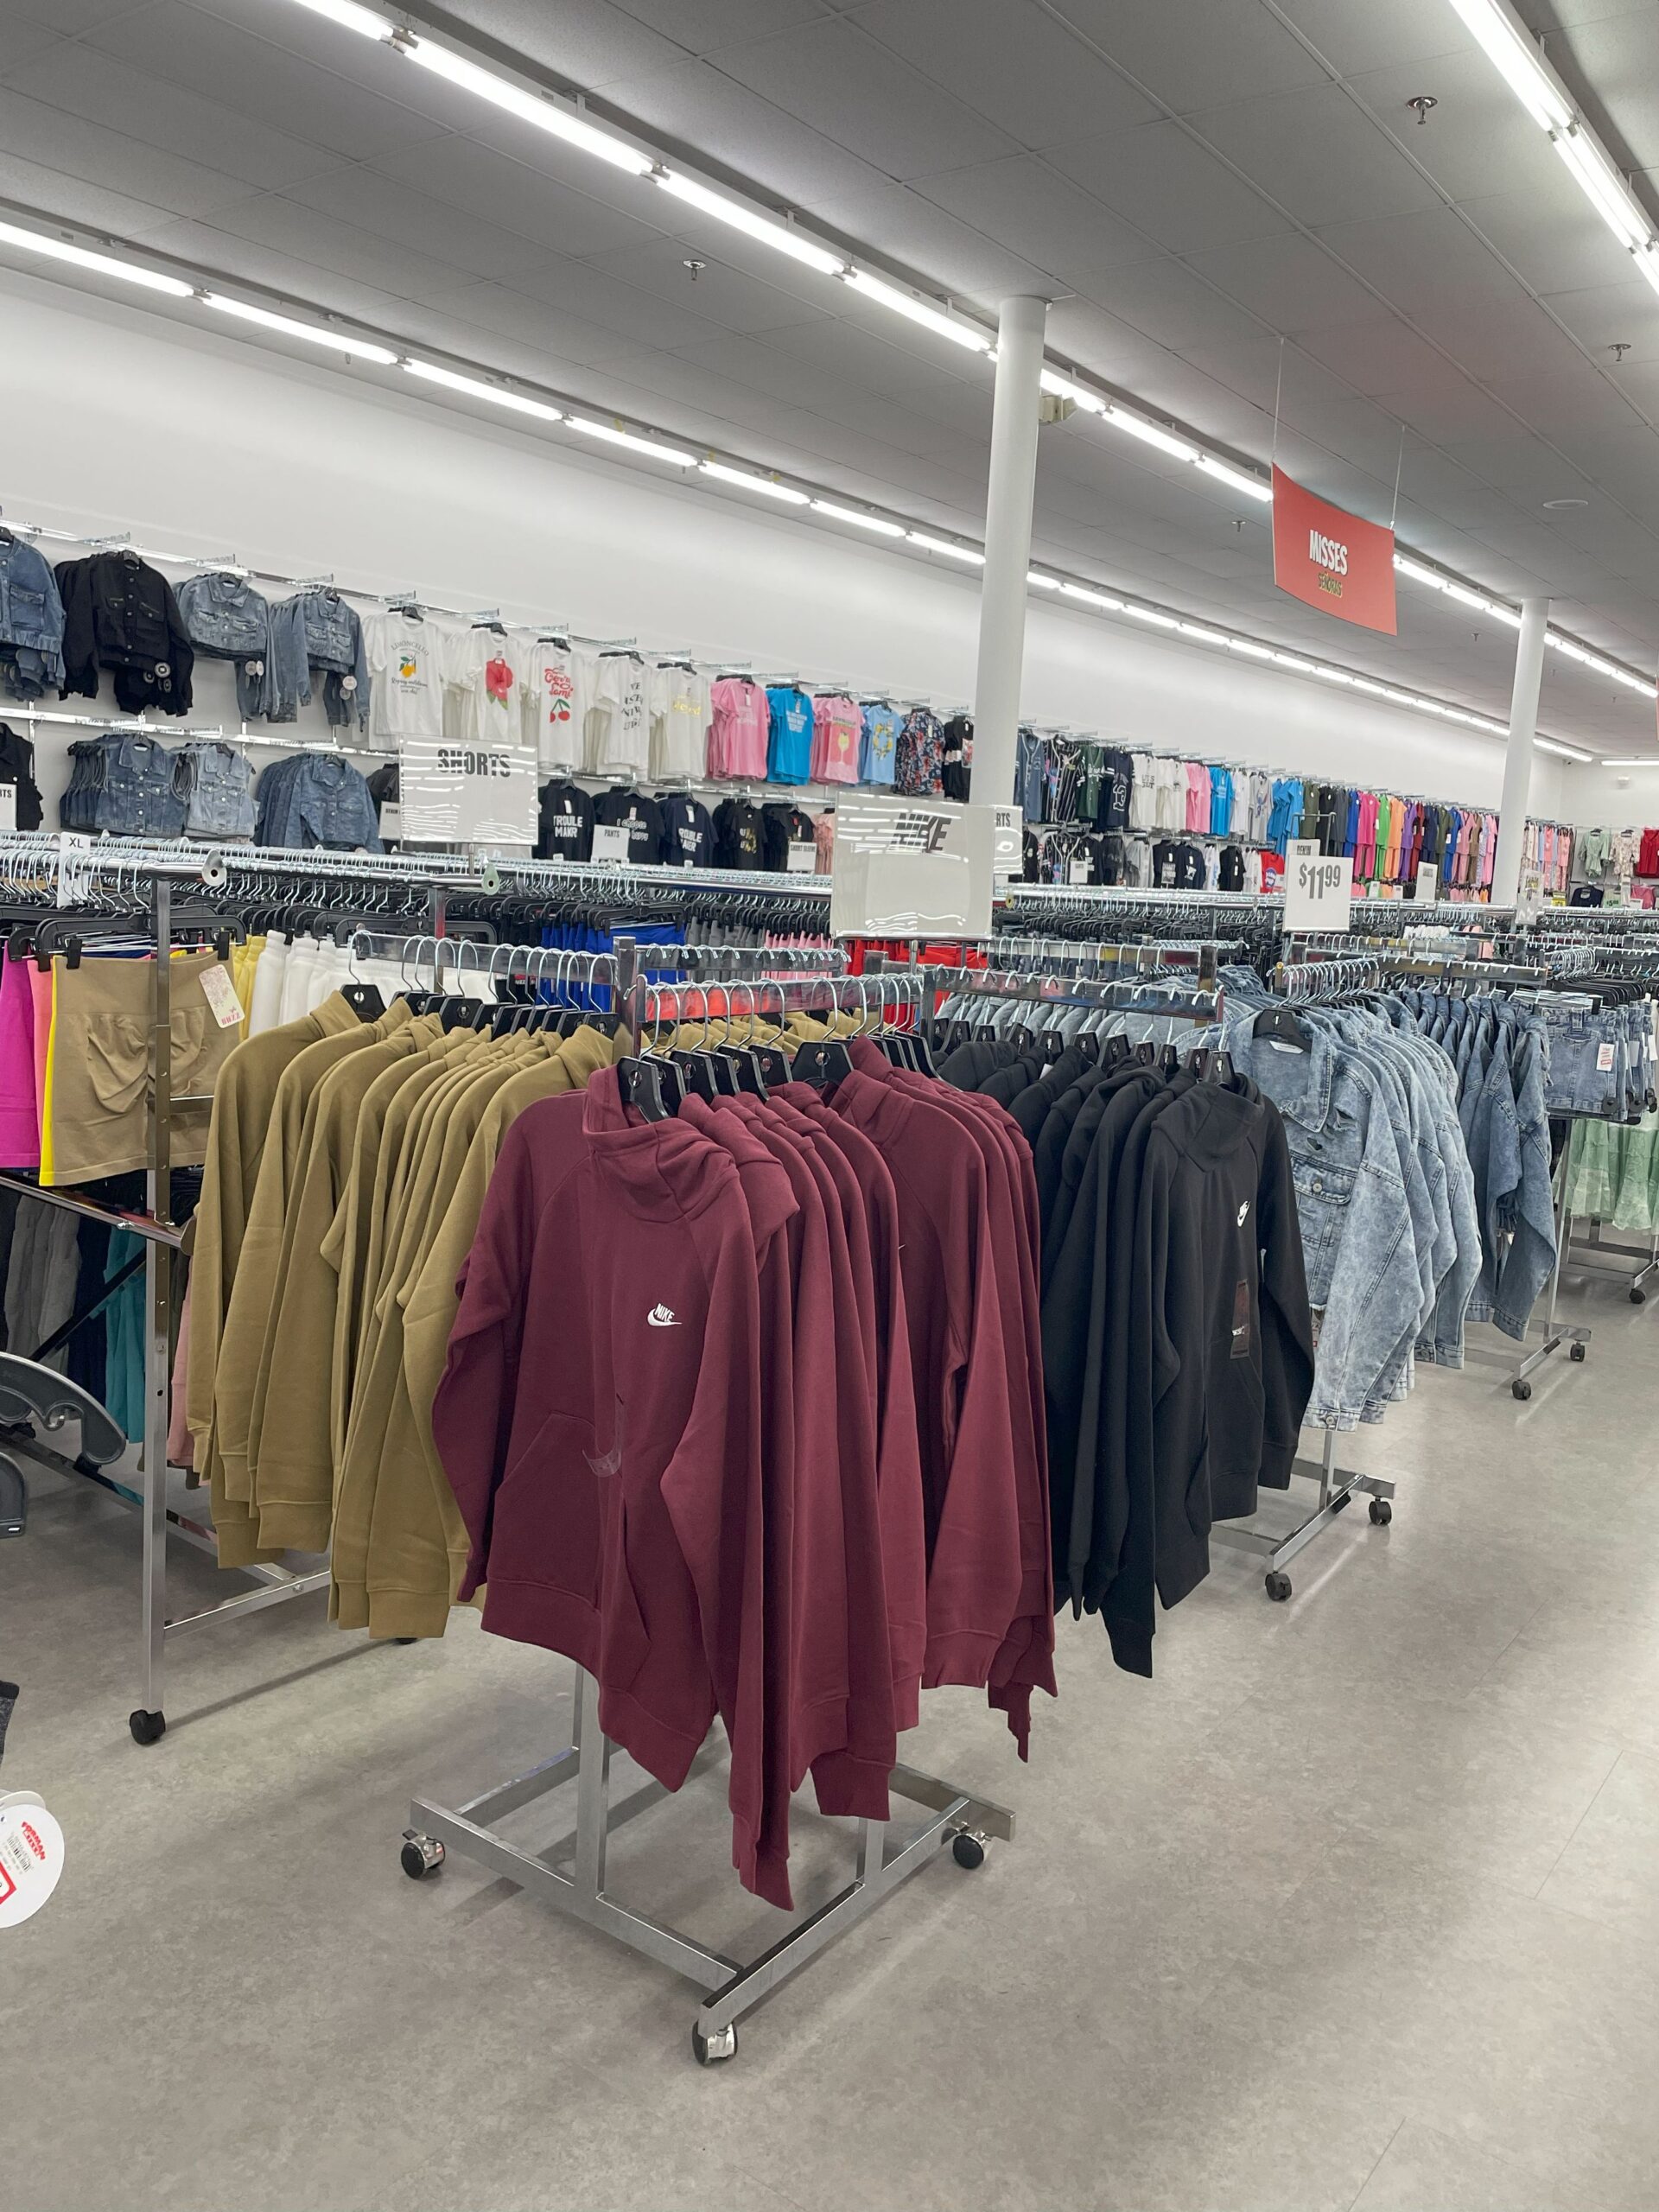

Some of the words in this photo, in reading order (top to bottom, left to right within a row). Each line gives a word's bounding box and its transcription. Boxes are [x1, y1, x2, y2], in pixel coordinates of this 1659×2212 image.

[1309, 529, 1348, 576] MISSES
[438, 749, 511, 778] SHORTS
[68, 836, 85, 849] XL
[604, 829, 620, 838] PANTS
[889, 812, 952, 853] NIKE
[654, 1303, 675, 1323] NIKE
